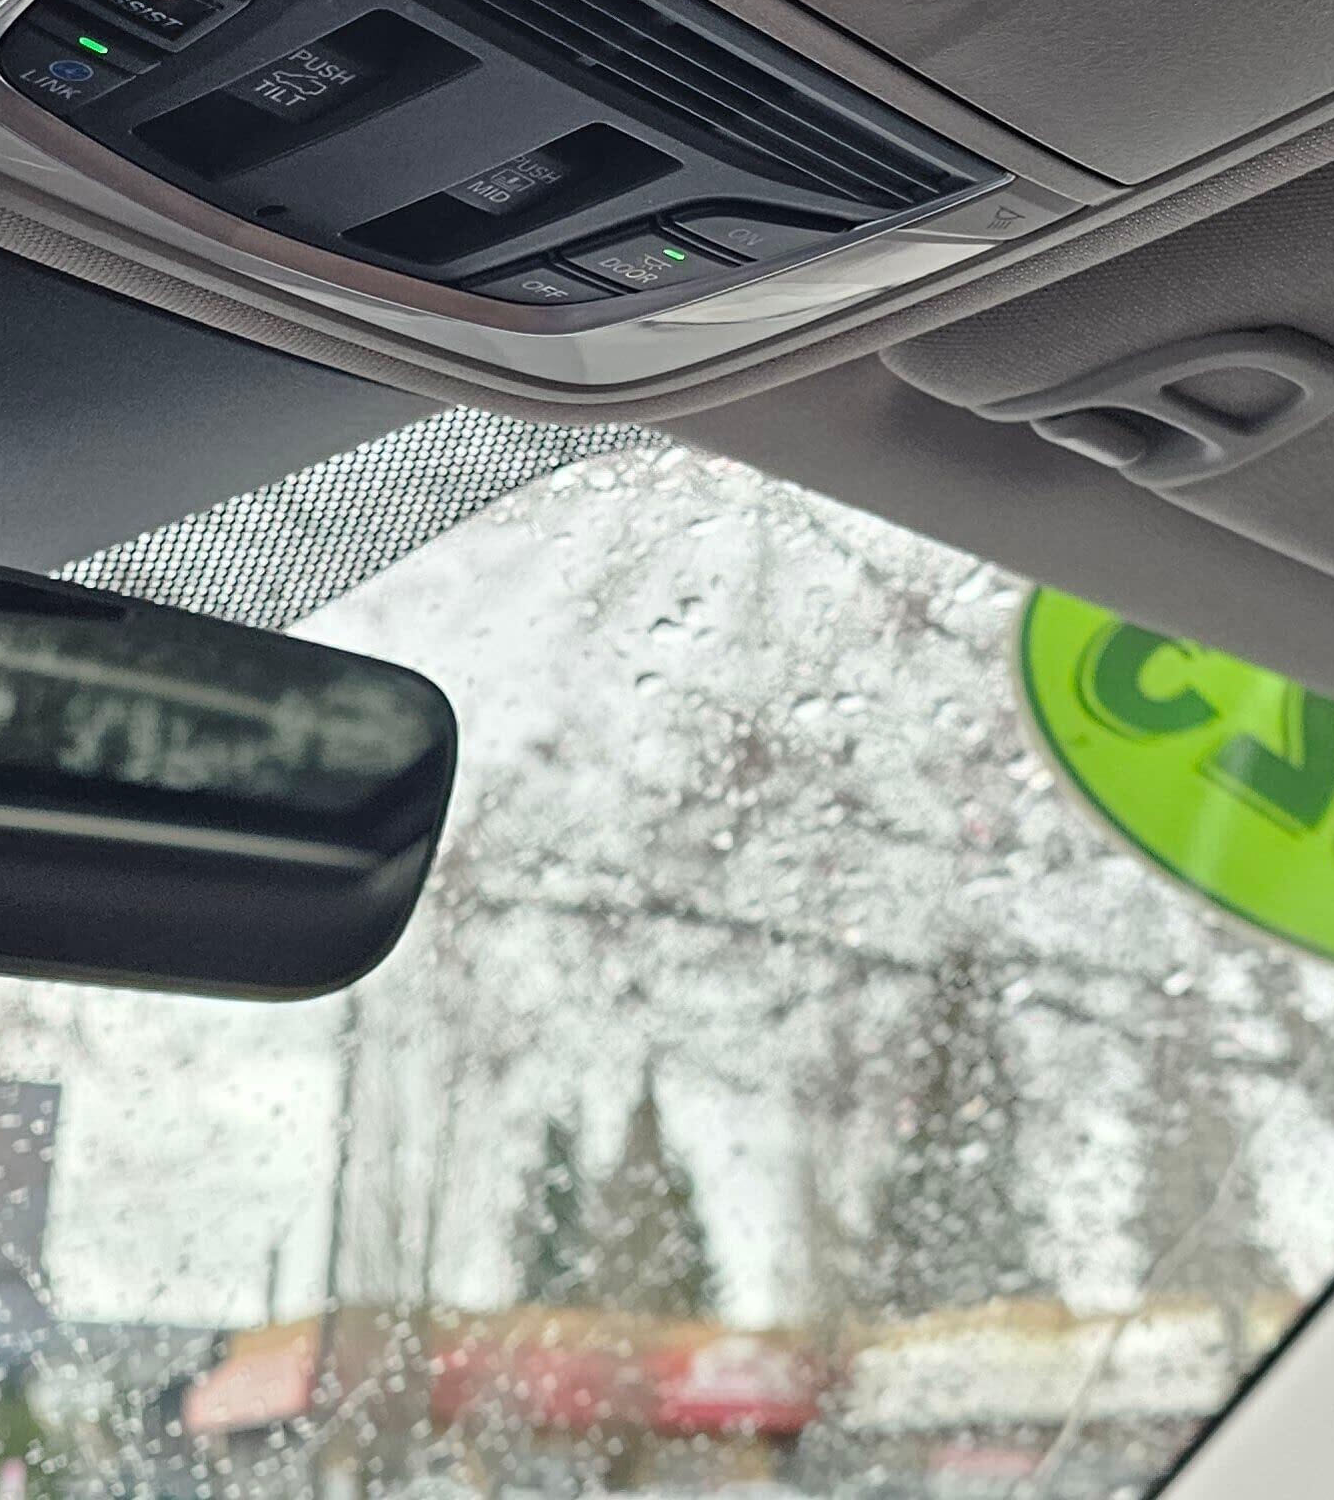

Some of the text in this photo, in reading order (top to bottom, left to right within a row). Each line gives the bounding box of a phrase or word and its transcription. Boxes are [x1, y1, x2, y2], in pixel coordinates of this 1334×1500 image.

[287, 48, 357, 86] PUSH
[19, 68, 82, 100] LINK
[253, 78, 307, 106] TILT
[466, 180, 511, 204] MID
[727, 227, 764, 247] ON
[597, 257, 660, 285] DOOR
[521, 279, 569, 299] OFF
